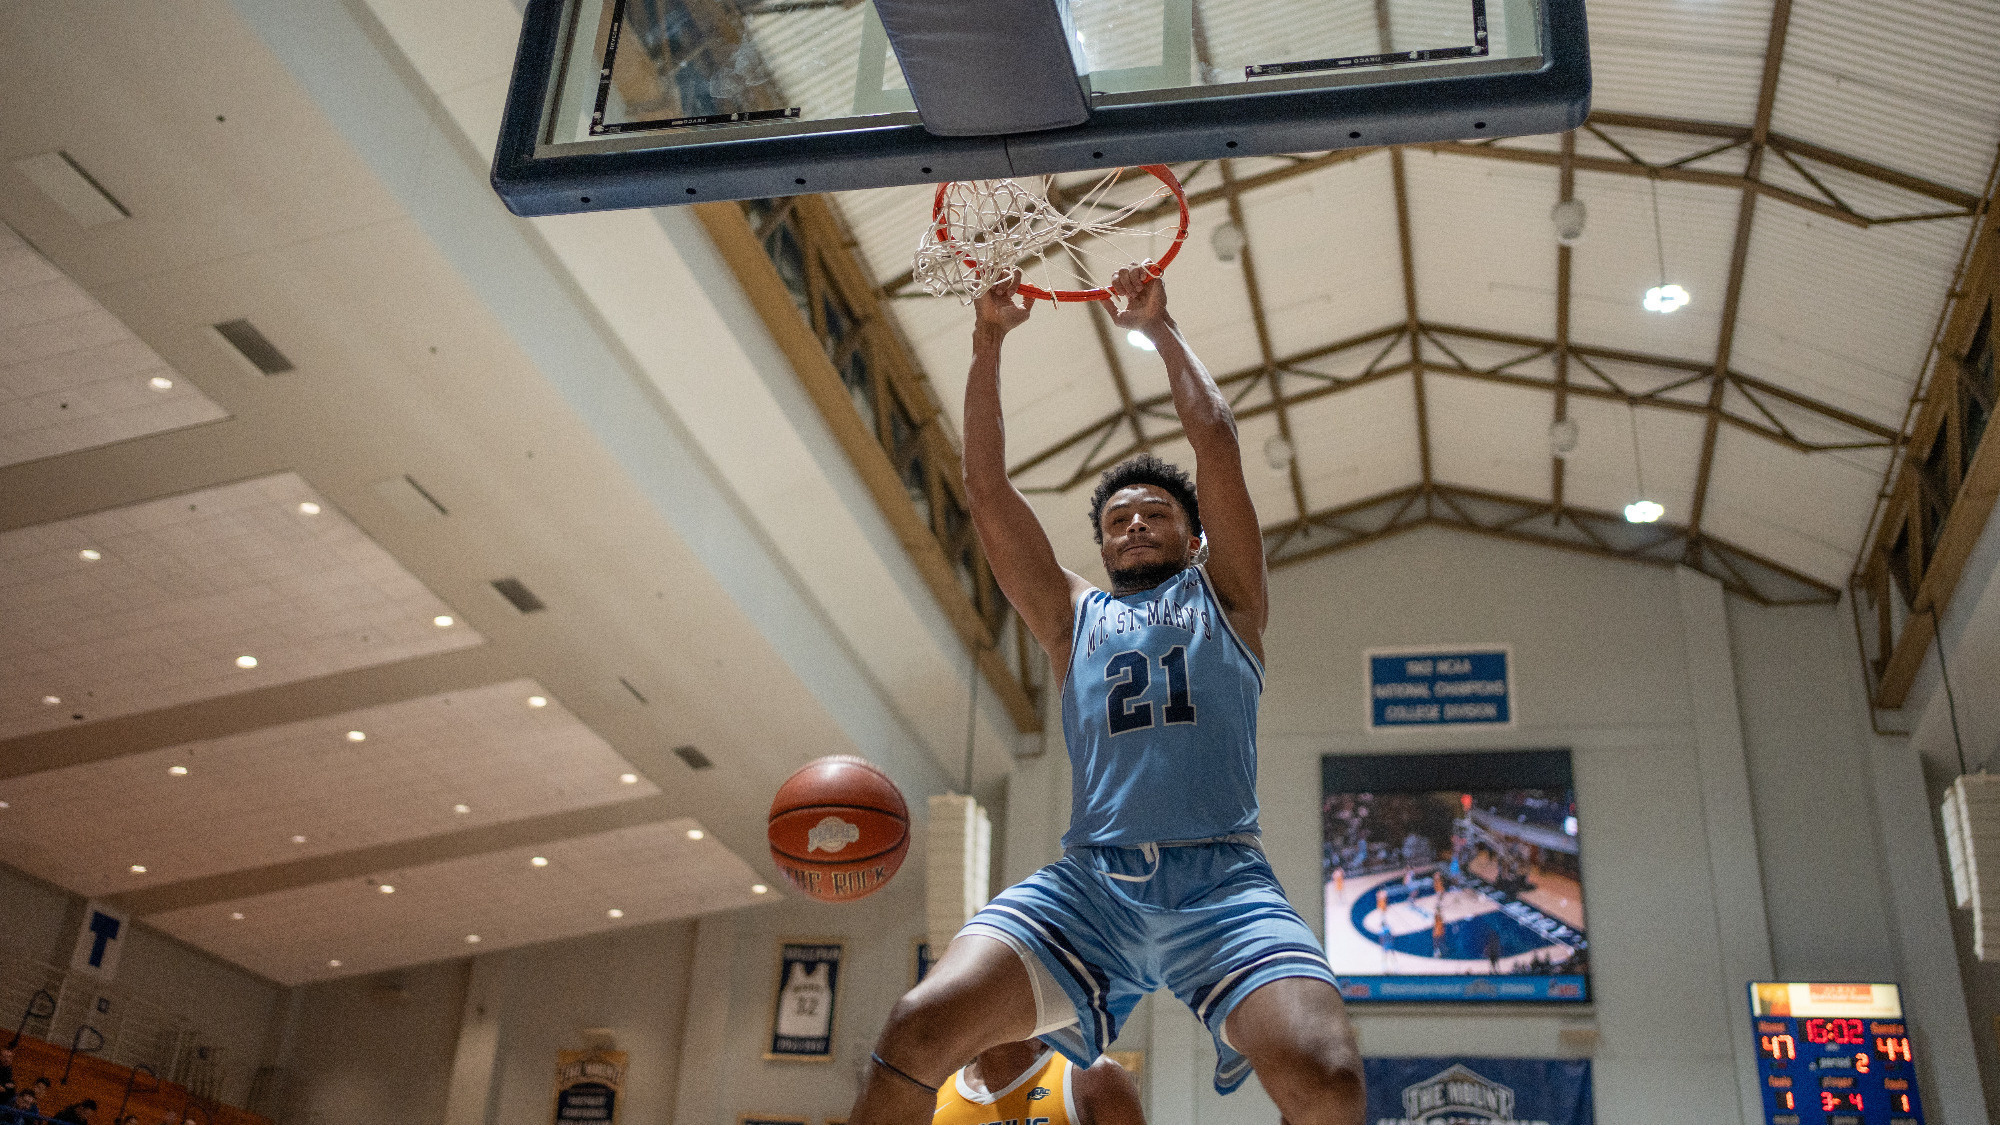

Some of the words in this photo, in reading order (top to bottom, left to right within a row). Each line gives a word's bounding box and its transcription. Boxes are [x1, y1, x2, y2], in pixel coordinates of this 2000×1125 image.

[1087, 616, 1110, 659] MT.
[1116, 607, 1141, 635] ST.
[1146, 599, 1212, 642] MARY'S
[1435, 658, 1472, 675] NCAA
[1104, 644, 1197, 737] 21
[1373, 682, 1431, 699] NATIONAL
[1433, 680, 1506, 697] CHAMPIONS
[1443, 702, 1497, 720] DIVISION
[832, 866, 885, 896] ROCK
[1806, 1018, 1864, 1044] 16:02
[1761, 1035, 1796, 1060] 47
[1876, 1037, 1911, 1062] 44
[1855, 1052, 1870, 1074] 2
[1410, 1083, 1445, 1116] THE
[1446, 1081, 1509, 1116] MOUNT
[1785, 1091, 1795, 1110] 1
[1848, 1093, 1864, 1111] 4
[1900, 1093, 1910, 1113] 1
